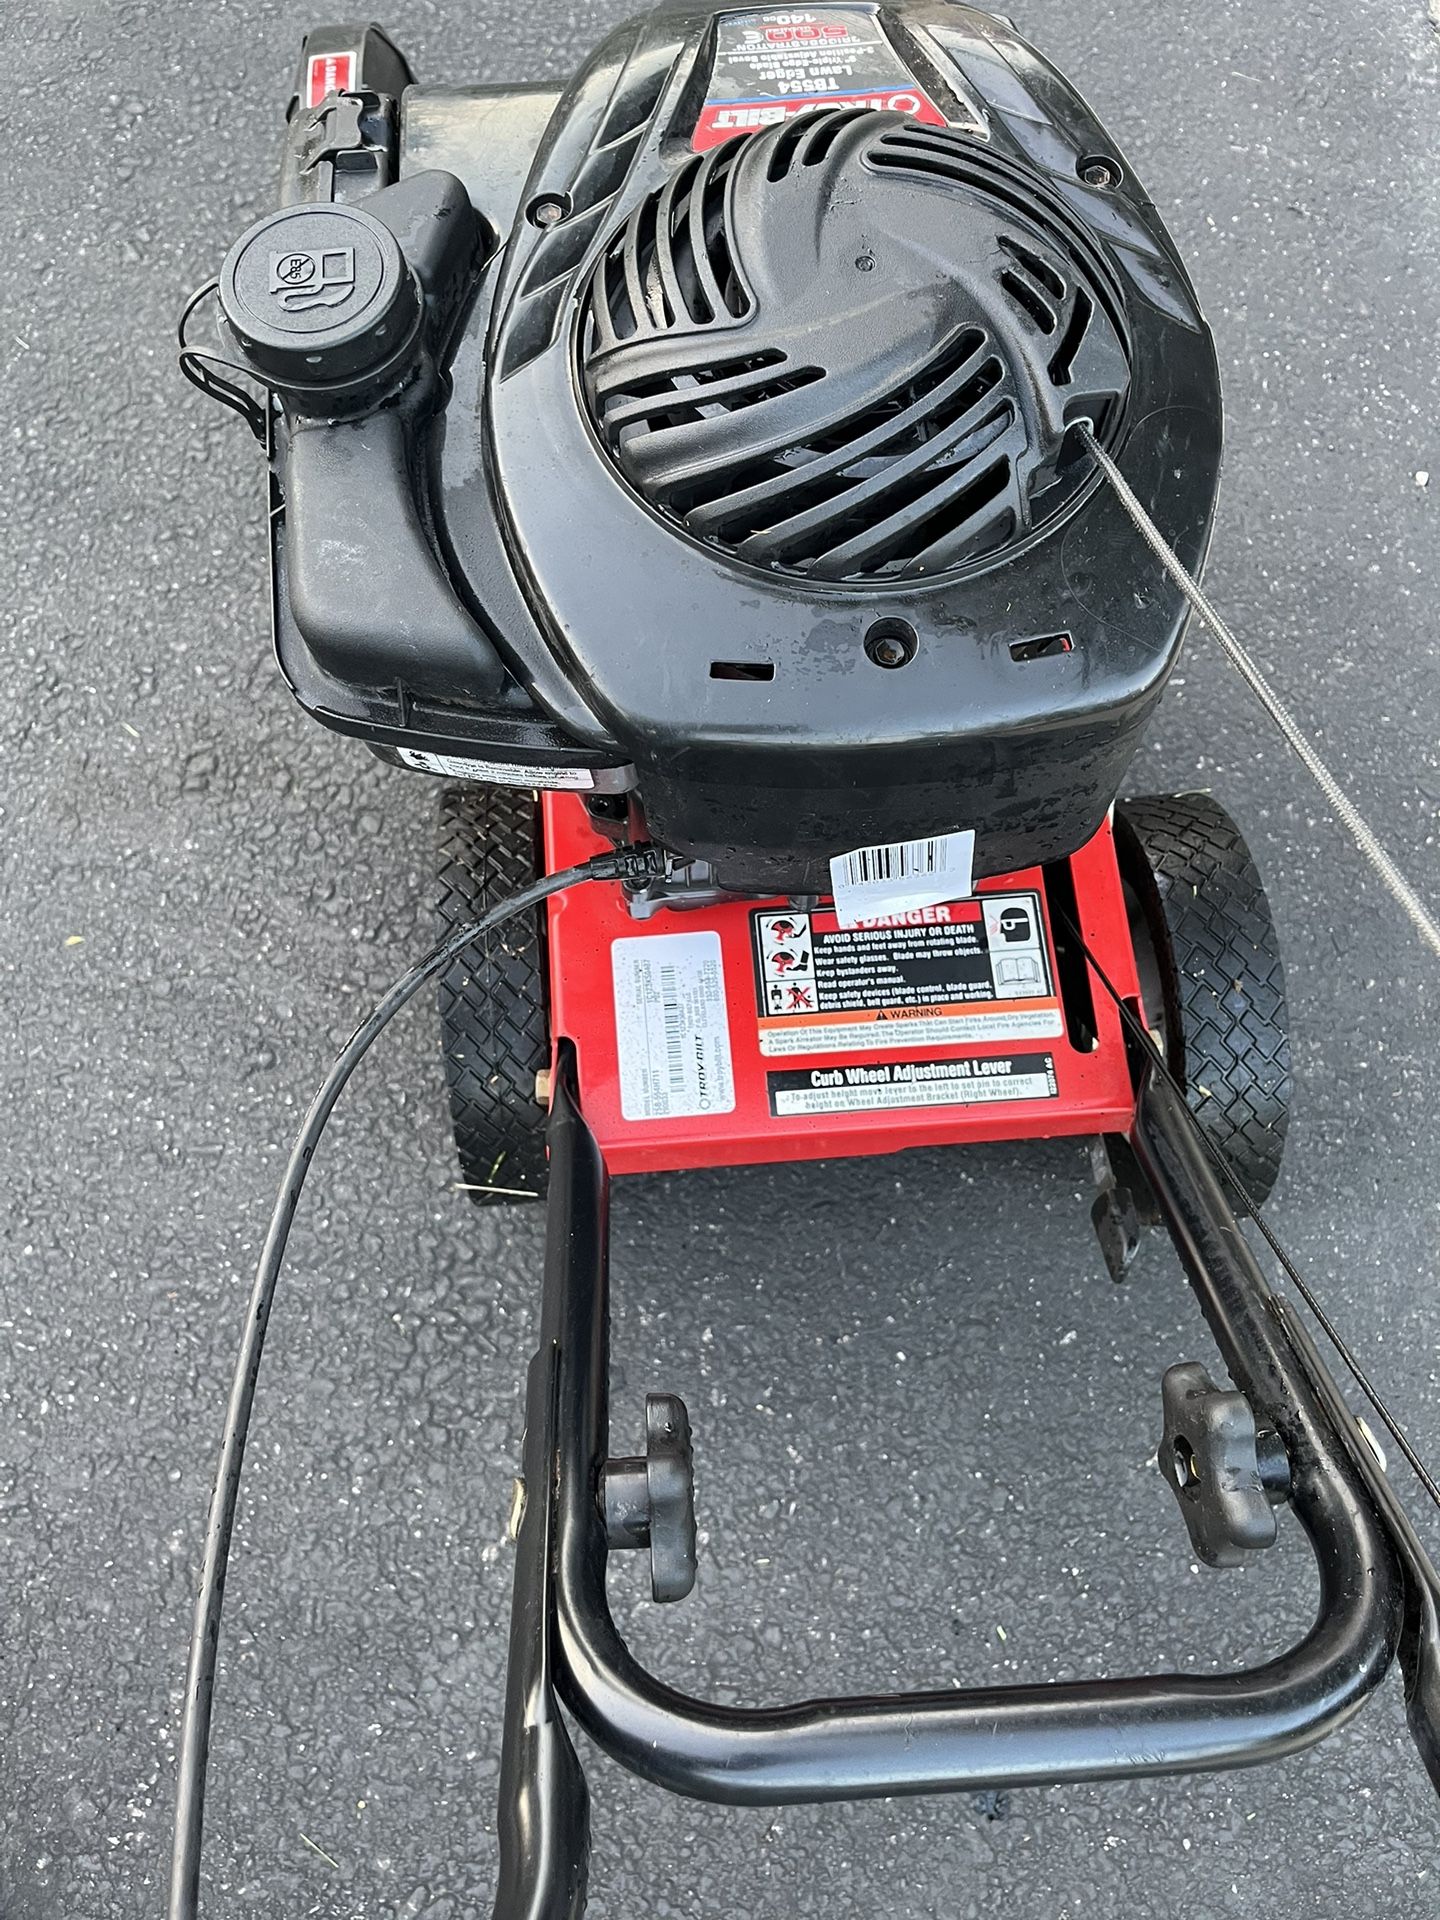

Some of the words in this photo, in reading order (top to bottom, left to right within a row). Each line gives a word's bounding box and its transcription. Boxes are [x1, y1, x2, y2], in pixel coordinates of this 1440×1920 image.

[760, 51, 817, 61] Adjustable
[749, 61, 780, 71] Blade
[759, 68, 805, 80] Edger
[809, 65, 852, 76] Lawn
[325, 65, 337, 94] DANG
[778, 77, 839, 94] TB554
[290, 259, 301, 279] E85
[823, 933, 851, 944] AVOID
[852, 929, 892, 942] SERIOUS
[893, 927, 926, 939] INJURY
[928, 926, 942, 936] OR
[944, 924, 974, 935] DEATH
[814, 946, 833, 955] Keep
[833, 944, 855, 953] hands
[857, 943, 871, 951] and
[888, 941, 906, 950] away
[926, 938, 955, 946] rotating
[815, 958, 834, 966] Wear
[836, 956, 858, 965] safety
[893, 952, 914, 960] Blade
[915, 951, 931, 959] may
[932, 949, 953, 957] throw
[816, 970, 835, 978] Keep
[836, 966, 876, 977] bystanders
[818, 980, 837, 988] Read
[838, 978, 875, 988] operator's
[819, 993, 838, 1001] Keep
[839, 990, 861, 999] safety
[862, 988, 890, 997] devices
[946, 982, 967, 991] blade
[930, 994, 949, 1003] place
[950, 992, 963, 1000] and
[890, 1007, 943, 1019] WARNING
[810, 1069, 844, 1087] Curb
[845, 1066, 891, 1085] Wheel
[893, 1061, 972, 1084] Adjustment
[972, 1060, 1012, 1076] Lever
[804, 1091, 829, 1101] adjust
[831, 1089, 858, 1098] height
[860, 1088, 882, 1097] move
[885, 1086, 907, 1094] lever
[908, 1085, 917, 1093] to
[934, 1082, 949, 1090] left
[962, 1081, 975, 1089] set
[977, 1080, 990, 1090] pin
[992, 1079, 1001, 1087] to
[1002, 1077, 1032, 1086] correct
[805, 1100, 832, 1110] height
[846, 1097, 874, 1106] Wheel
[877, 1094, 924, 1106] Adjustment
[926, 1091, 958, 1101] Bracket
